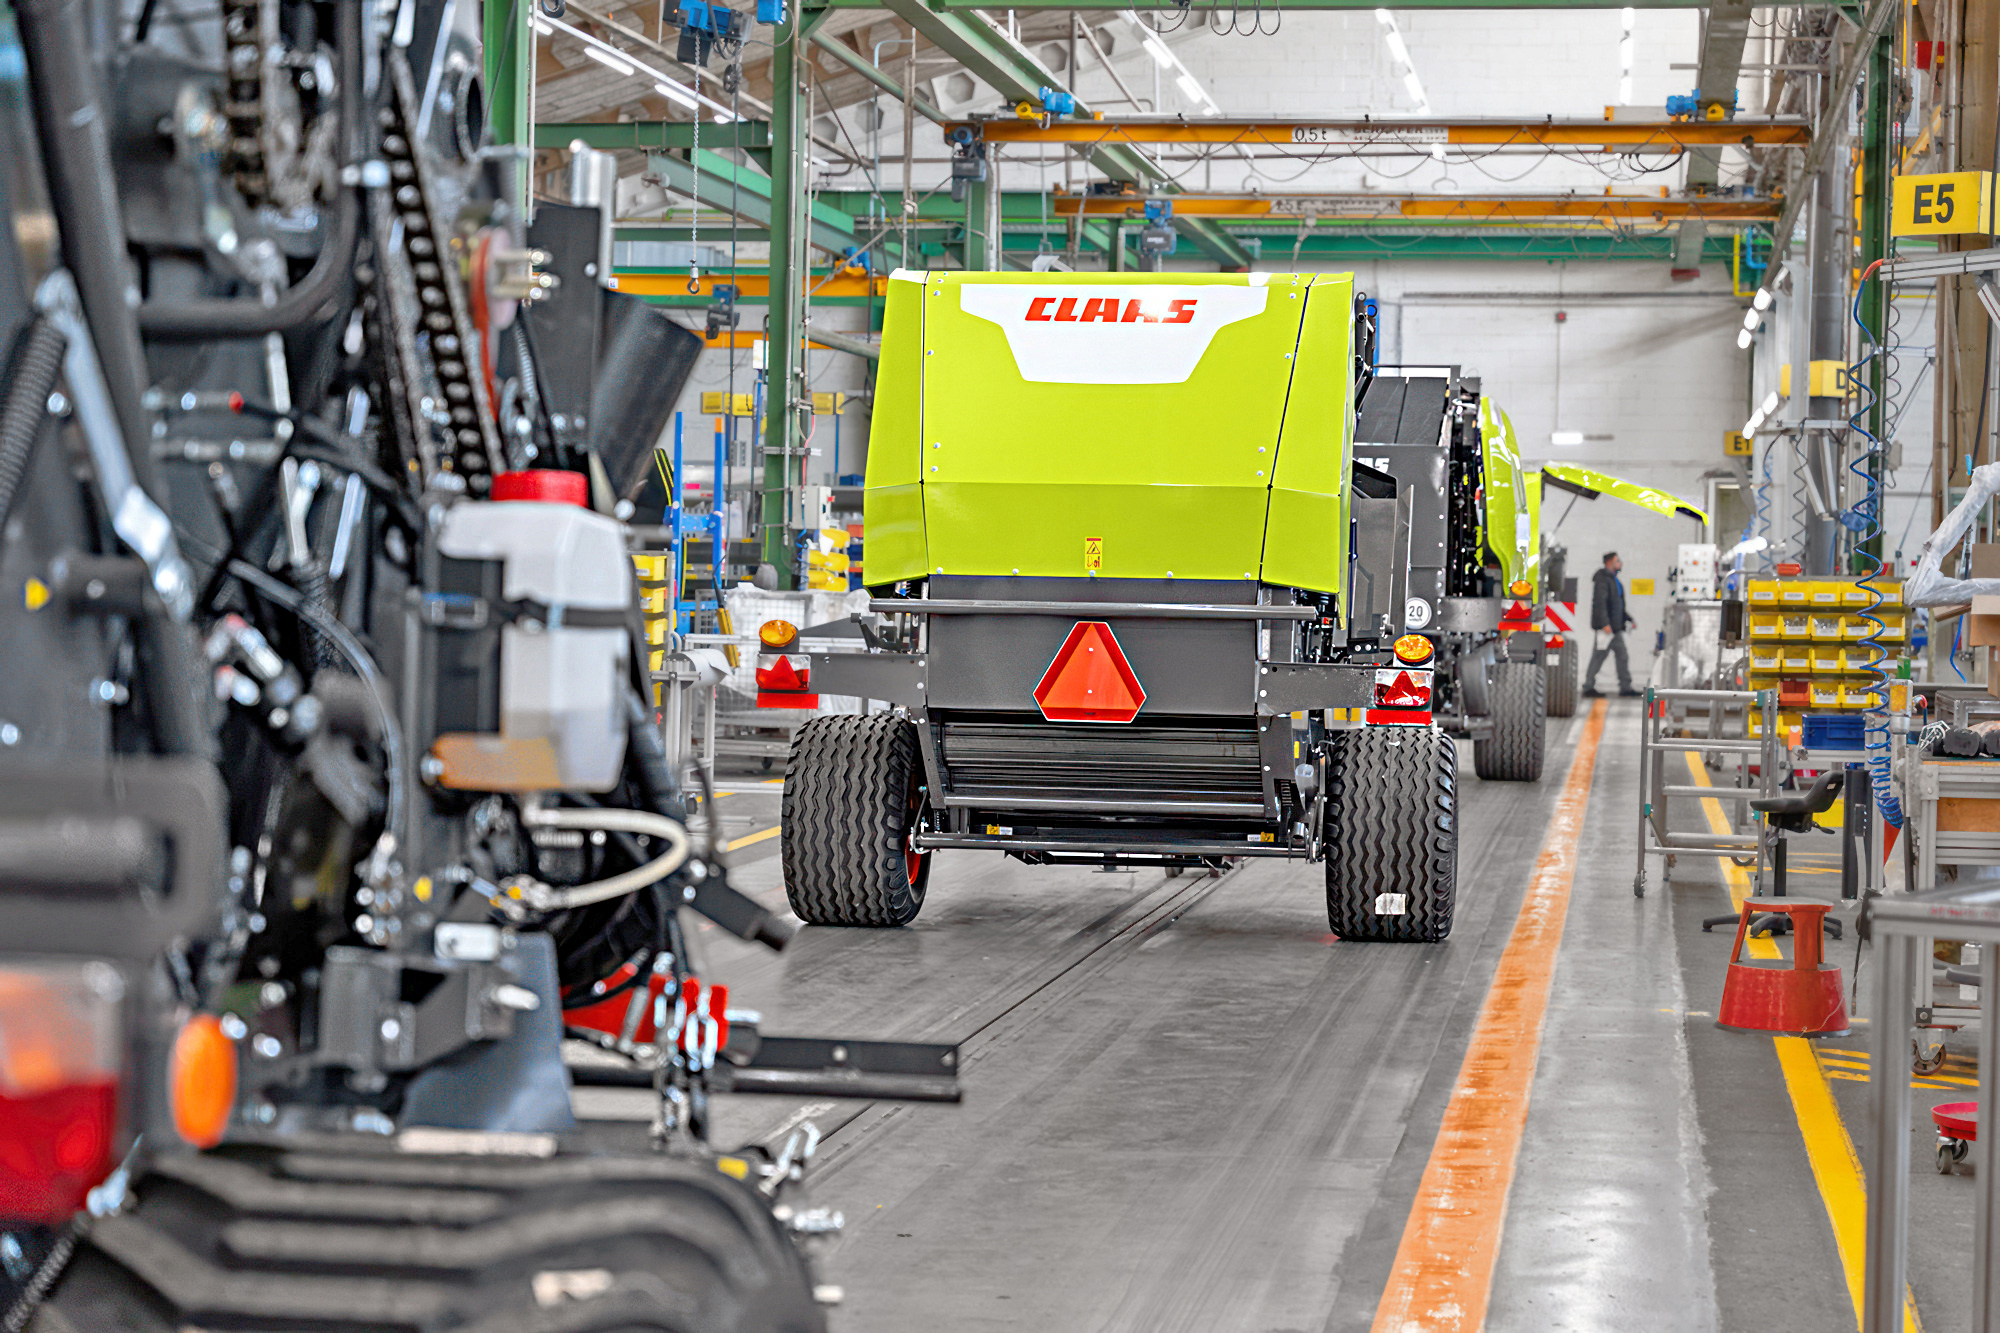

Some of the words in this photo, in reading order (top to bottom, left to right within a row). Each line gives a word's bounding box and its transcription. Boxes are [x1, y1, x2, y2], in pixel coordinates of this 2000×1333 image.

[1295, 127, 1318, 143] 0,5
[1913, 183, 1955, 224] E5
[1024, 297, 1198, 324] CLAAS
[1408, 605, 1423, 617] 20
